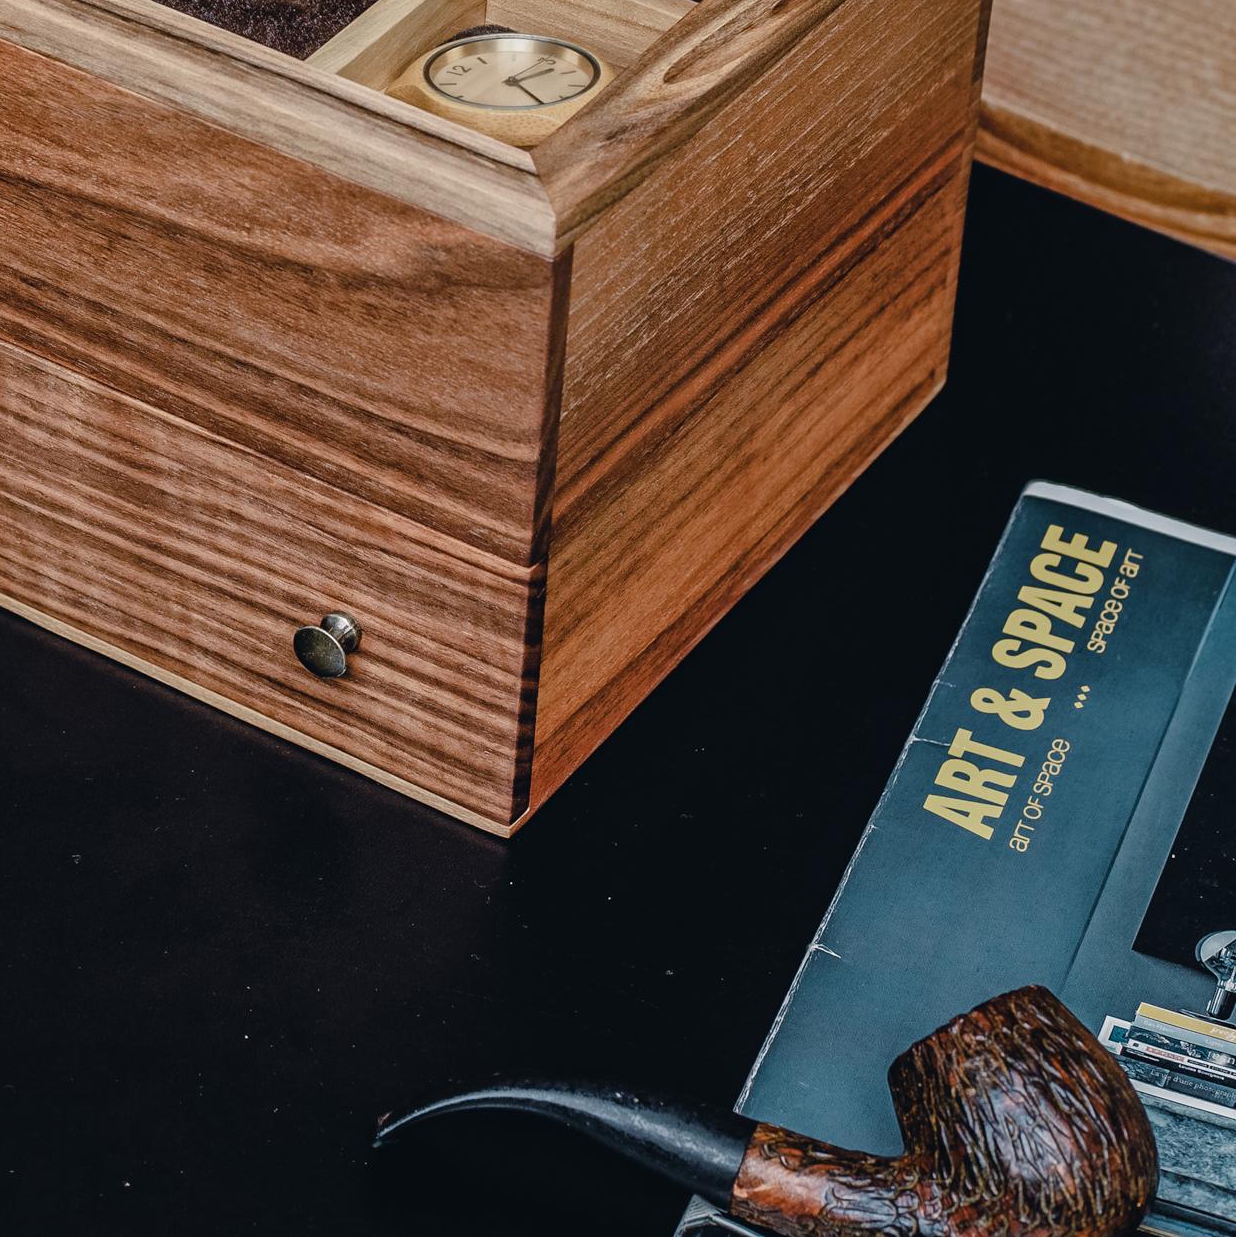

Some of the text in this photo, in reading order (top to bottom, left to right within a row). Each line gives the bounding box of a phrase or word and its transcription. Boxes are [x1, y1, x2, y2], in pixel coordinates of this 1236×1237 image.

[446, 65, 472, 76] 12
[922, 524, 1118, 840] ART & SPACE
